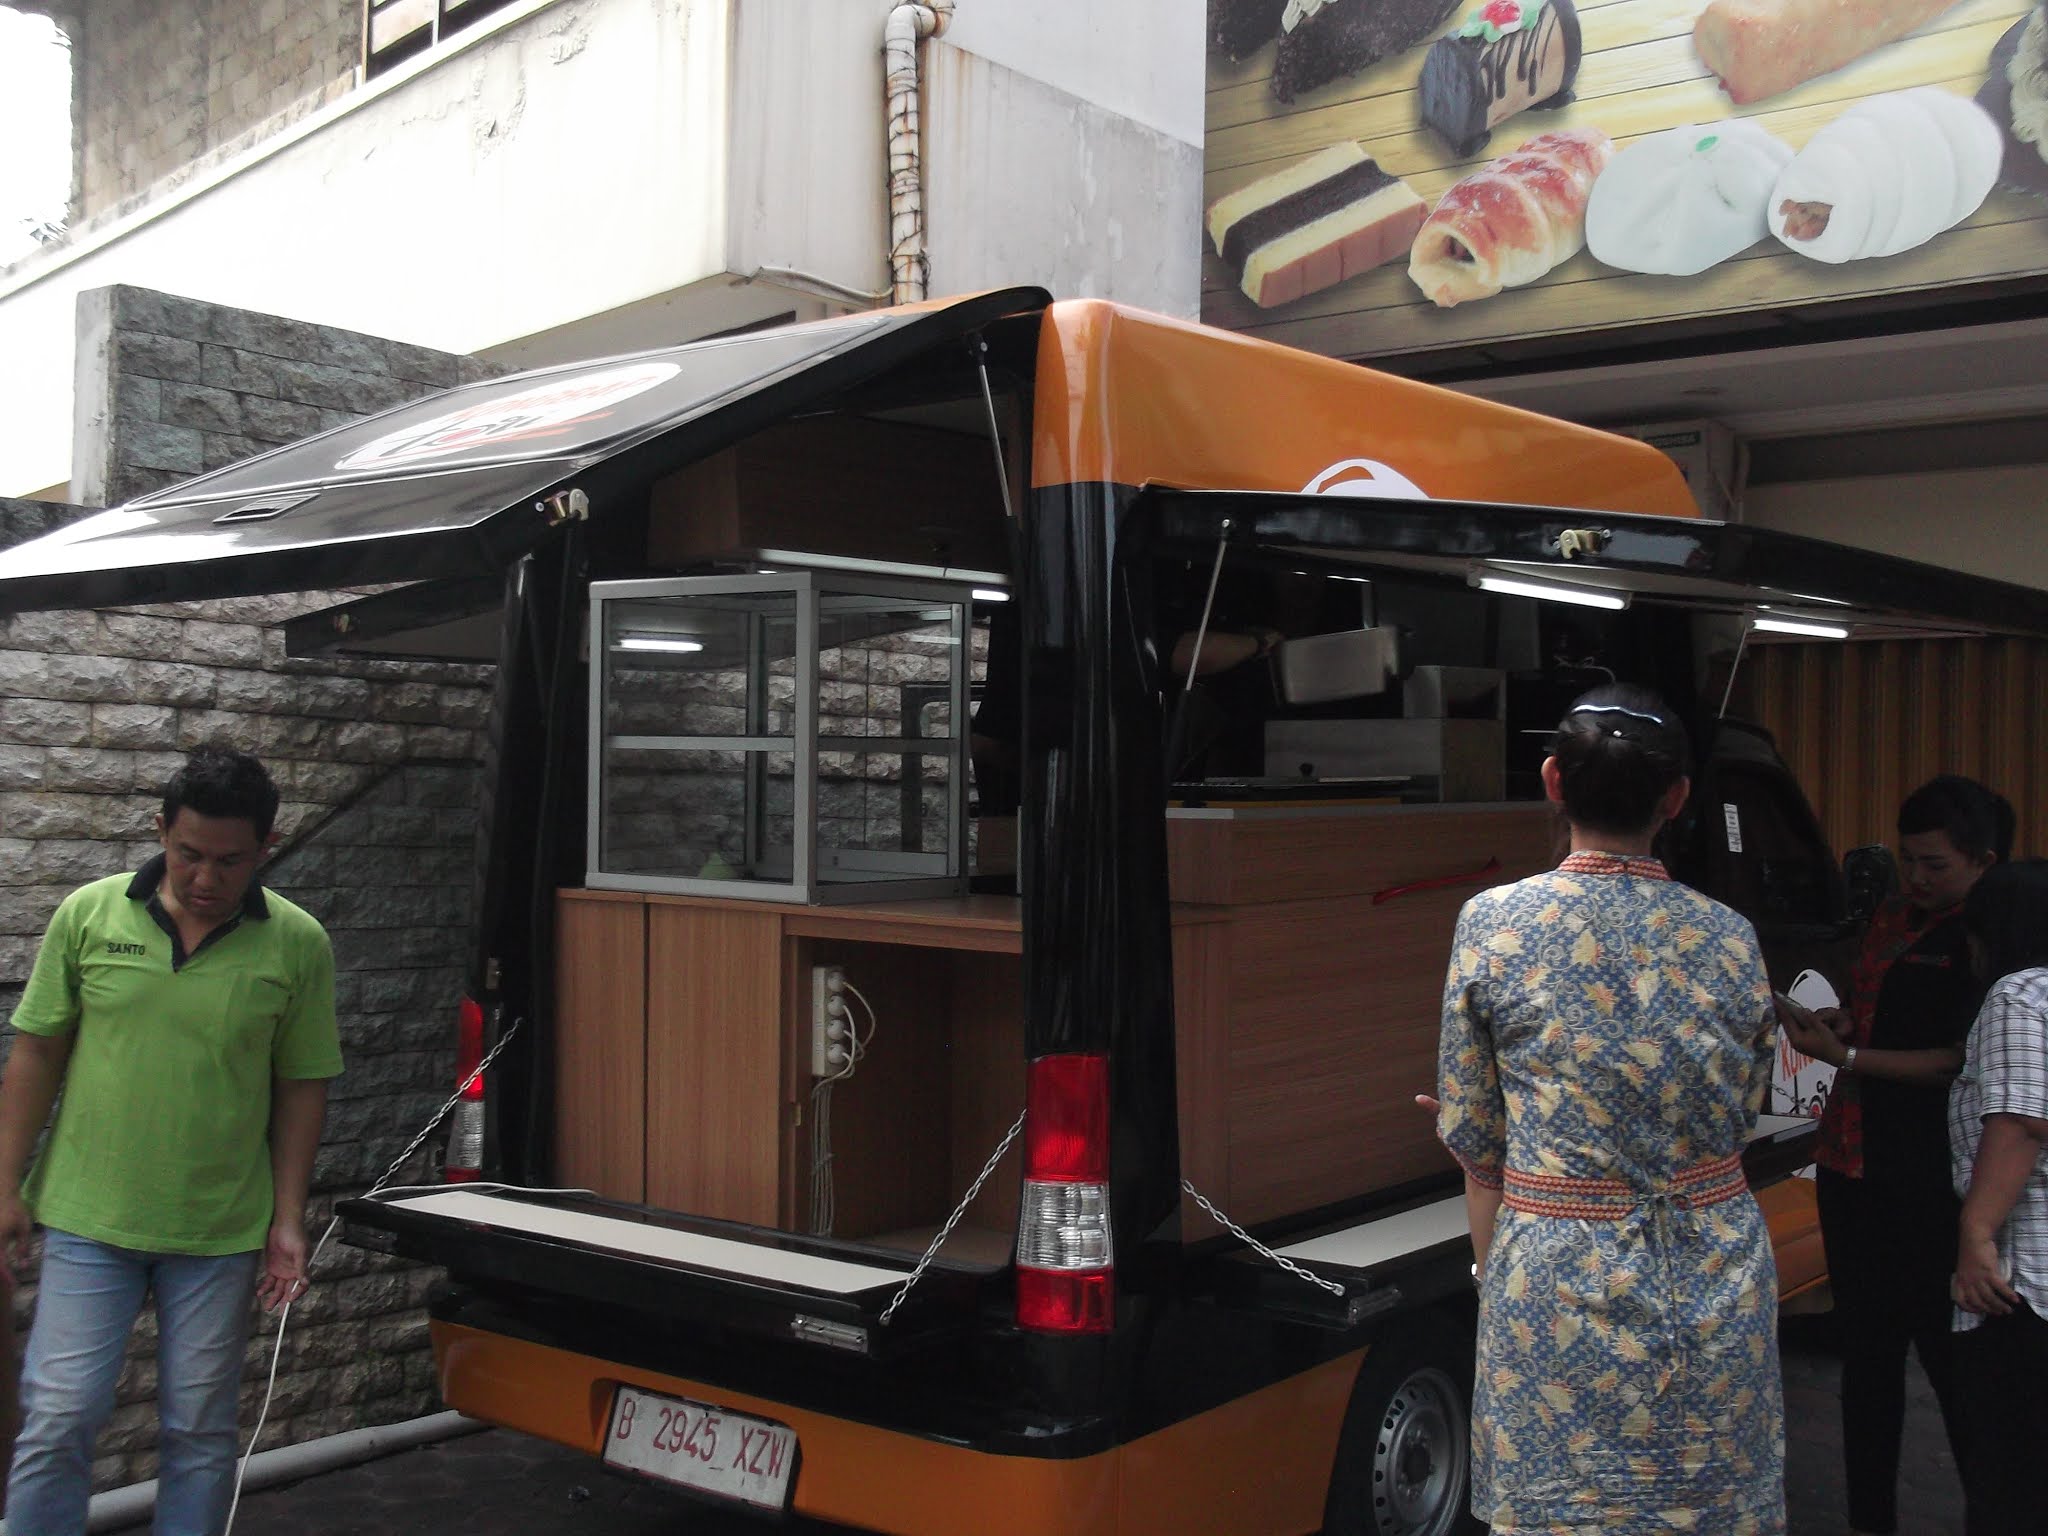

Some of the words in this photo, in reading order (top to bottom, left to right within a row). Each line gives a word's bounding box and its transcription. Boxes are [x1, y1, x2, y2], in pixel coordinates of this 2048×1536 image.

[107, 942, 146, 956] SANTO
[617, 1397, 636, 1440] B
[653, 1407, 721, 1462] 2945
[733, 1426, 787, 1479] XZW
